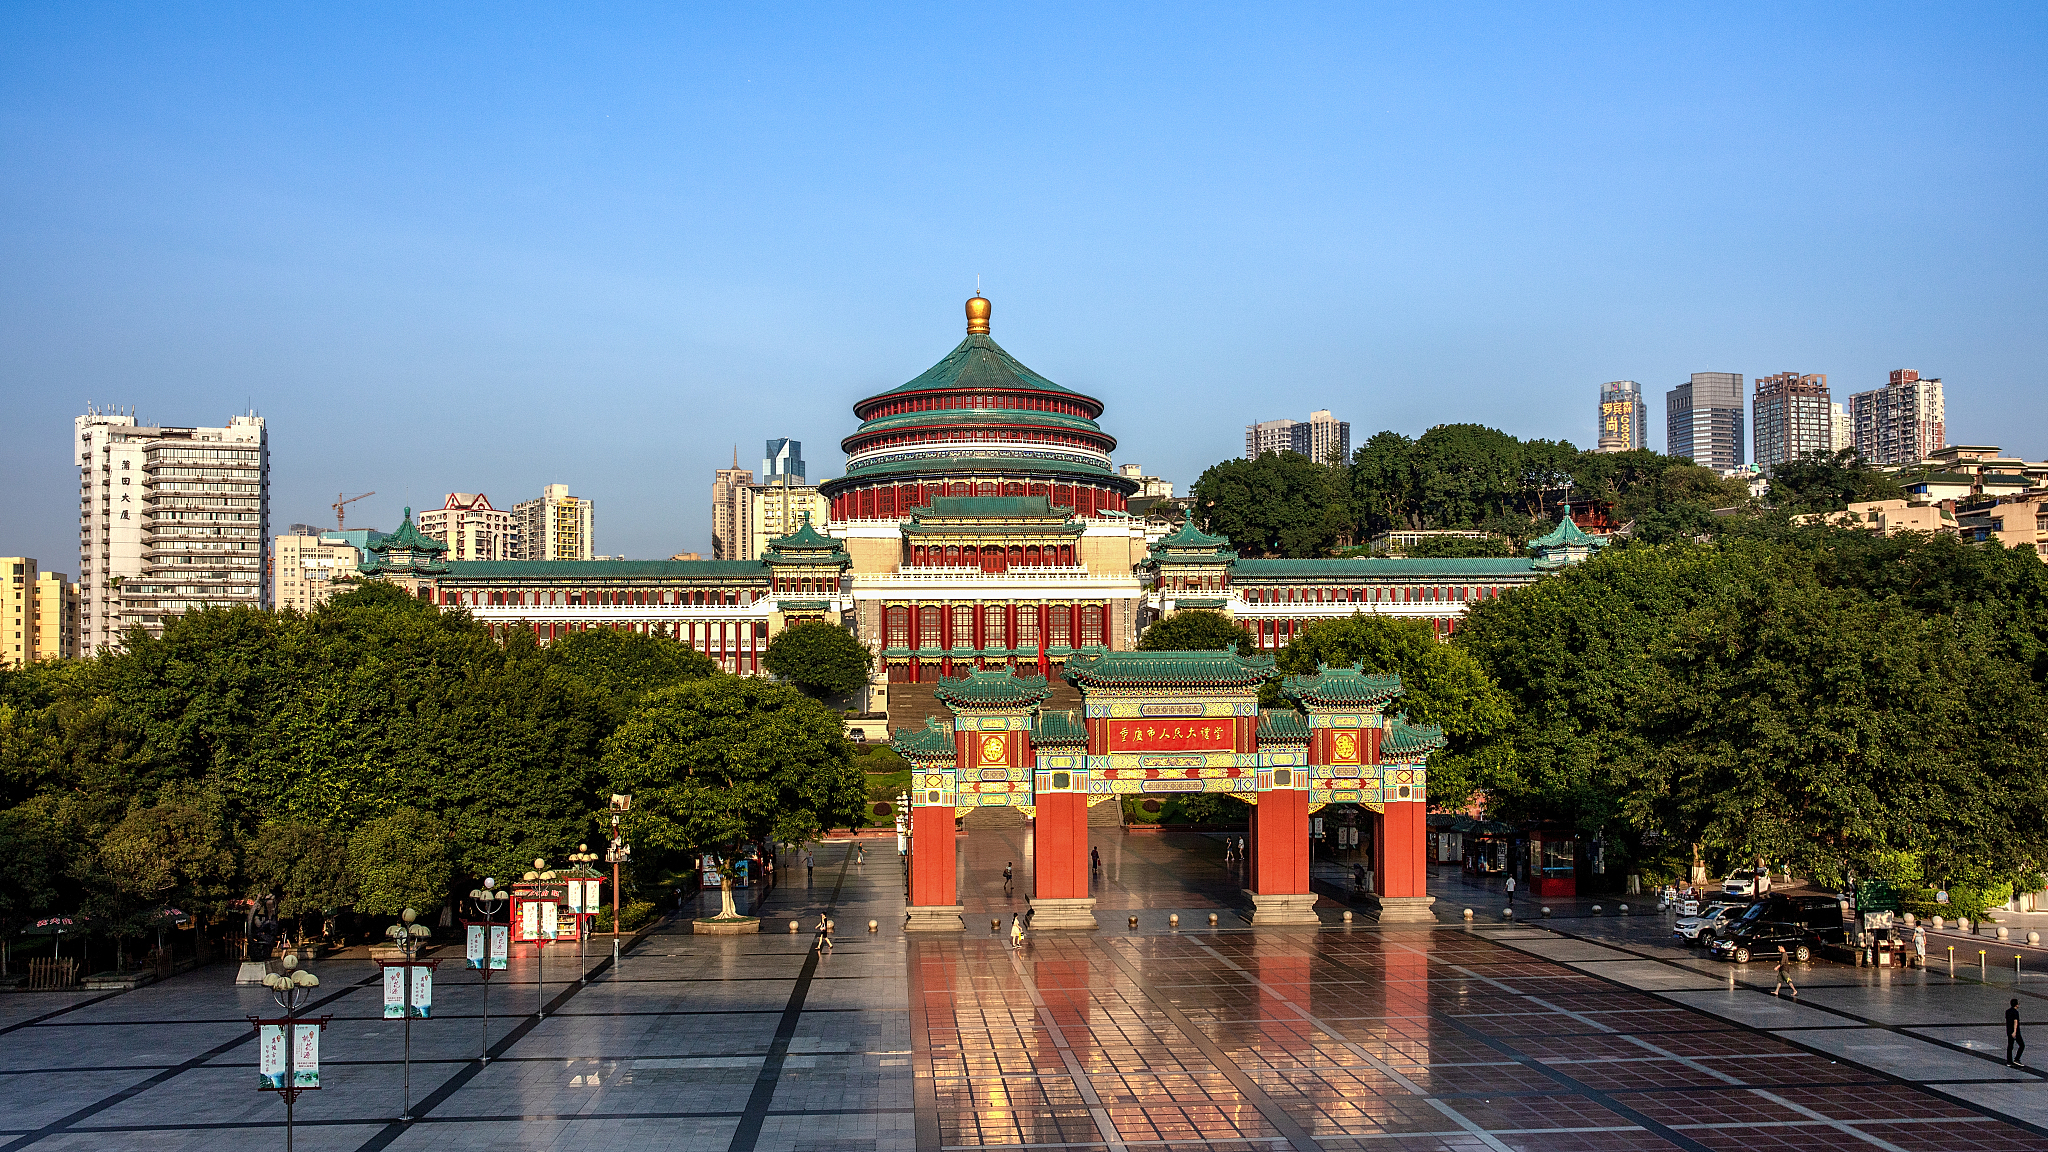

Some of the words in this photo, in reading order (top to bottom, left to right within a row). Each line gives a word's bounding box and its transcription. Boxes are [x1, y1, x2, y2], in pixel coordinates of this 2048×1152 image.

[1603, 401, 1632, 417] 罗宾森
[1605, 416, 1619, 437] 尚
[302, 1034, 314, 1059] 桃花源
